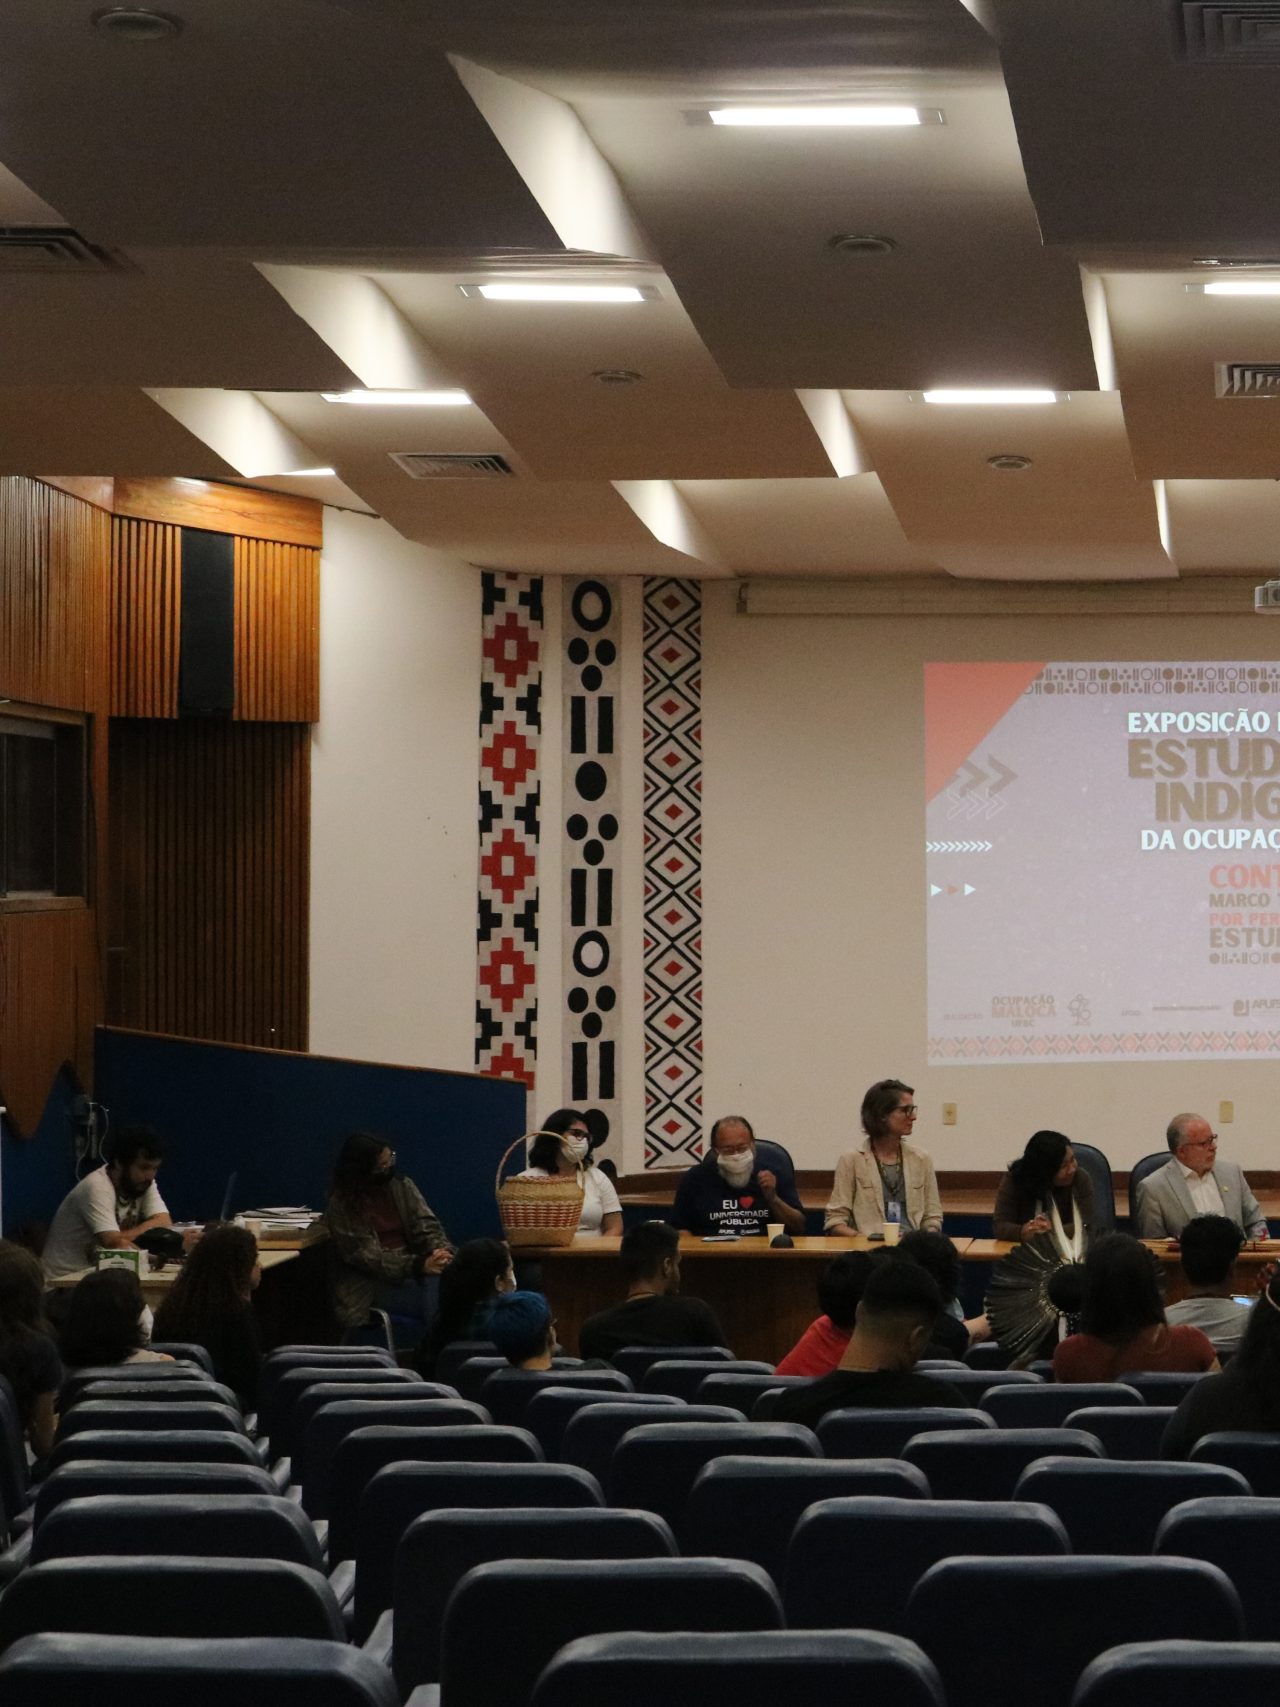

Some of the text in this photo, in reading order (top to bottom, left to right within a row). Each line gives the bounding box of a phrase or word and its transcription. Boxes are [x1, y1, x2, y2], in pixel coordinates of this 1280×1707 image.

[1128, 709, 1270, 735] EXPOSIÇÃO
[1141, 829, 1176, 850] DA
[1209, 893, 1270, 907] MARCO
[1209, 912, 1244, 926] POR
[722, 1199, 738, 1210] EU
[709, 1209, 769, 1220] UNIVERSIDADE
